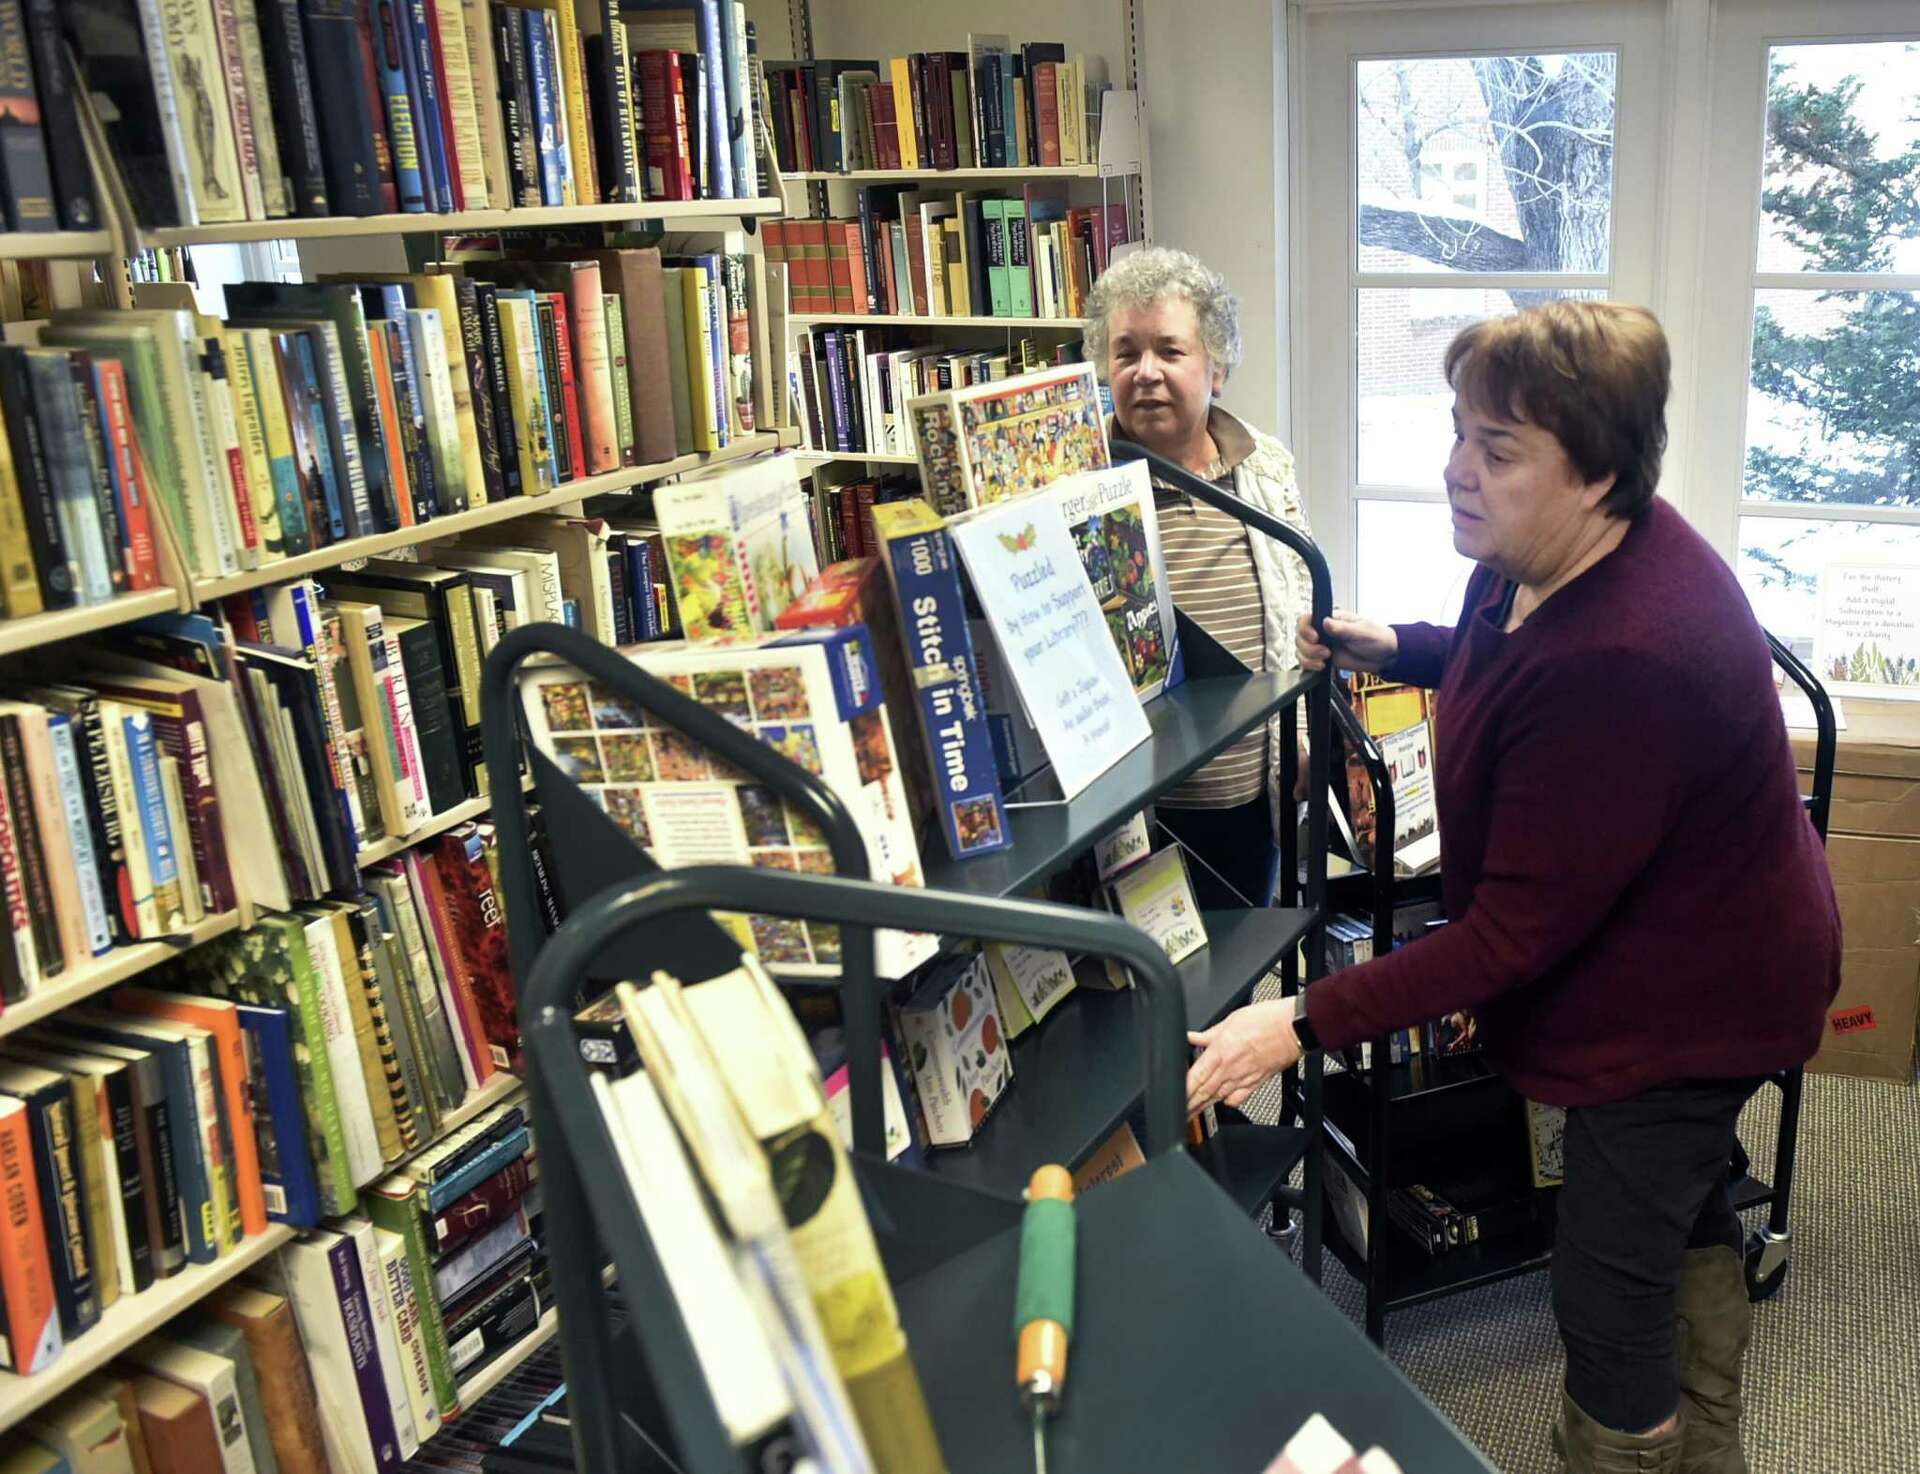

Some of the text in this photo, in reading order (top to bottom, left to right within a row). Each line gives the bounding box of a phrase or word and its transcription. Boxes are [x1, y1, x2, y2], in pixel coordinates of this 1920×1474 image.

[443, 44, 465, 69] THE
[515, 49, 524, 80] STORM
[533, 40, 549, 118] Nelson DeMille
[389, 95, 419, 170] ELECTION
[508, 100, 519, 137] PHILIP
[618, 108, 633, 174] RECKONING
[512, 142, 523, 171] ROTH
[461, 306, 476, 352] BALOGH
[471, 314, 484, 346] MARY
[484, 294, 506, 392] CATCHING BABIES
[555, 313, 569, 373] Frostfire
[233, 345, 249, 388] Jeffrey
[241, 393, 262, 456] Eugenides
[324, 328, 369, 512] THE SUBMISSION AMY WALDMAN
[354, 326, 383, 449] The Good Sister
[924, 412, 948, 472] Rock
[1097, 478, 1132, 503] Puzzle
[910, 538, 932, 576] 1000
[1010, 556, 1056, 592] Puzzled
[384, 645, 410, 726] BERLIN
[913, 596, 969, 792] Stitch in Time
[86, 730, 123, 846] PETERSBURG
[1832, 1012, 1872, 1030] HEAVY
[0, 1129, 28, 1228] HARLAN COBEN
[155, 1107, 181, 1241] THE INTERNATIONAL STYLE
[384, 1259, 413, 1345] BETTER CARB
[400, 1255, 420, 1327] GOOD CARB
[410, 1340, 430, 1397] COOKBOOK
